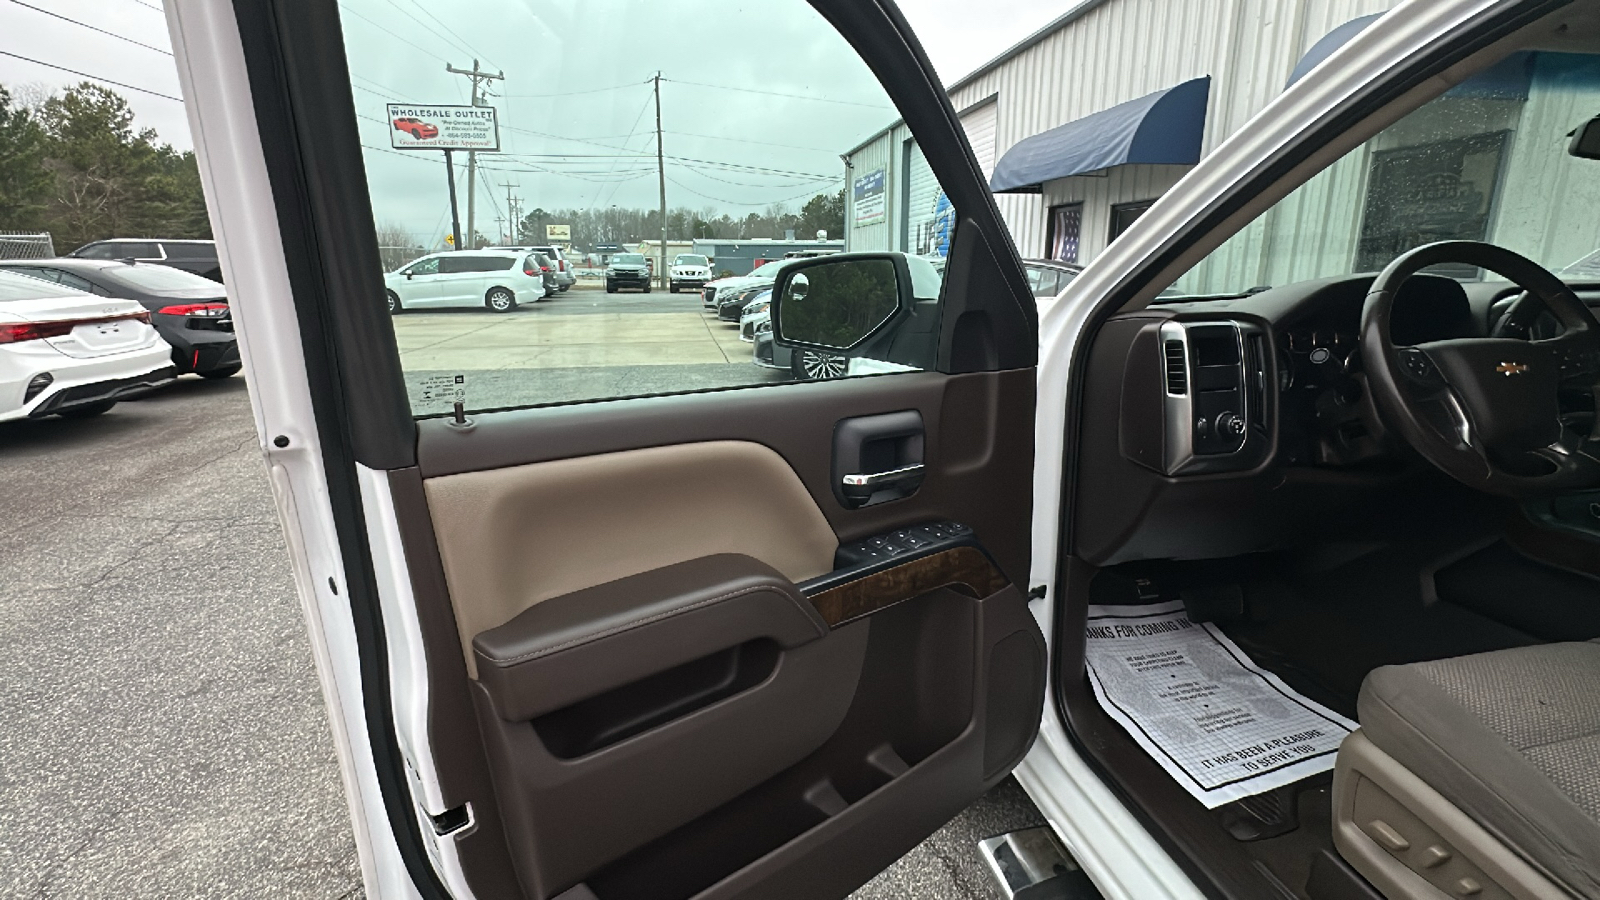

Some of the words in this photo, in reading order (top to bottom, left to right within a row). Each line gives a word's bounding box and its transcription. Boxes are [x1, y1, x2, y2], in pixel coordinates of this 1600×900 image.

[391, 110, 451, 118] WHOLESALE
[1087, 626, 1115, 638] ANKS
[1114, 624, 1138, 638] FOR
[1135, 621, 1179, 636] COMING
[1177, 618, 1192, 628] IN
[1201, 760, 1214, 769] IT
[1212, 754, 1238, 765] HAS
[1235, 745, 1266, 759] BEEN
[1264, 742, 1276, 750] A
[1271, 730, 1325, 747] PLEASURE
[1241, 762, 1259, 772] TO
[1257, 750, 1294, 766] SERVE
[1290, 744, 1316, 755] YOU
